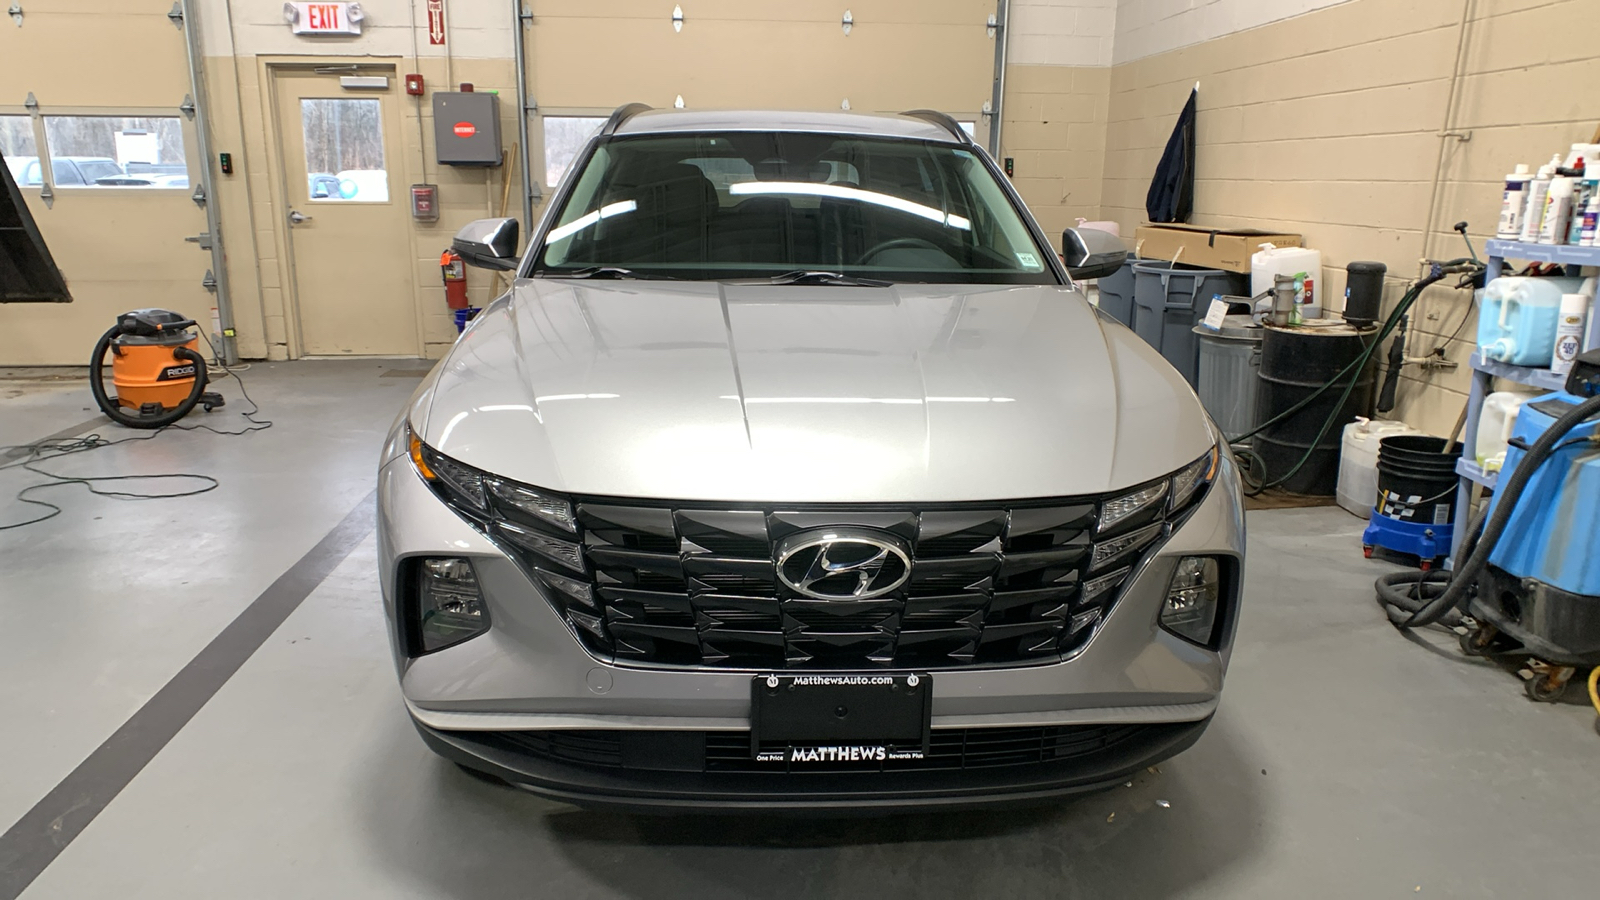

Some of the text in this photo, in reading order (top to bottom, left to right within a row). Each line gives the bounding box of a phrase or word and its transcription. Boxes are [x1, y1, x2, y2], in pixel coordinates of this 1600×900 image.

[308, 4, 339, 29] EXIT
[793, 676, 893, 686] MatthewsAuto.com
[769, 754, 784, 762] Price
[791, 746, 886, 762] MATTHEWS
